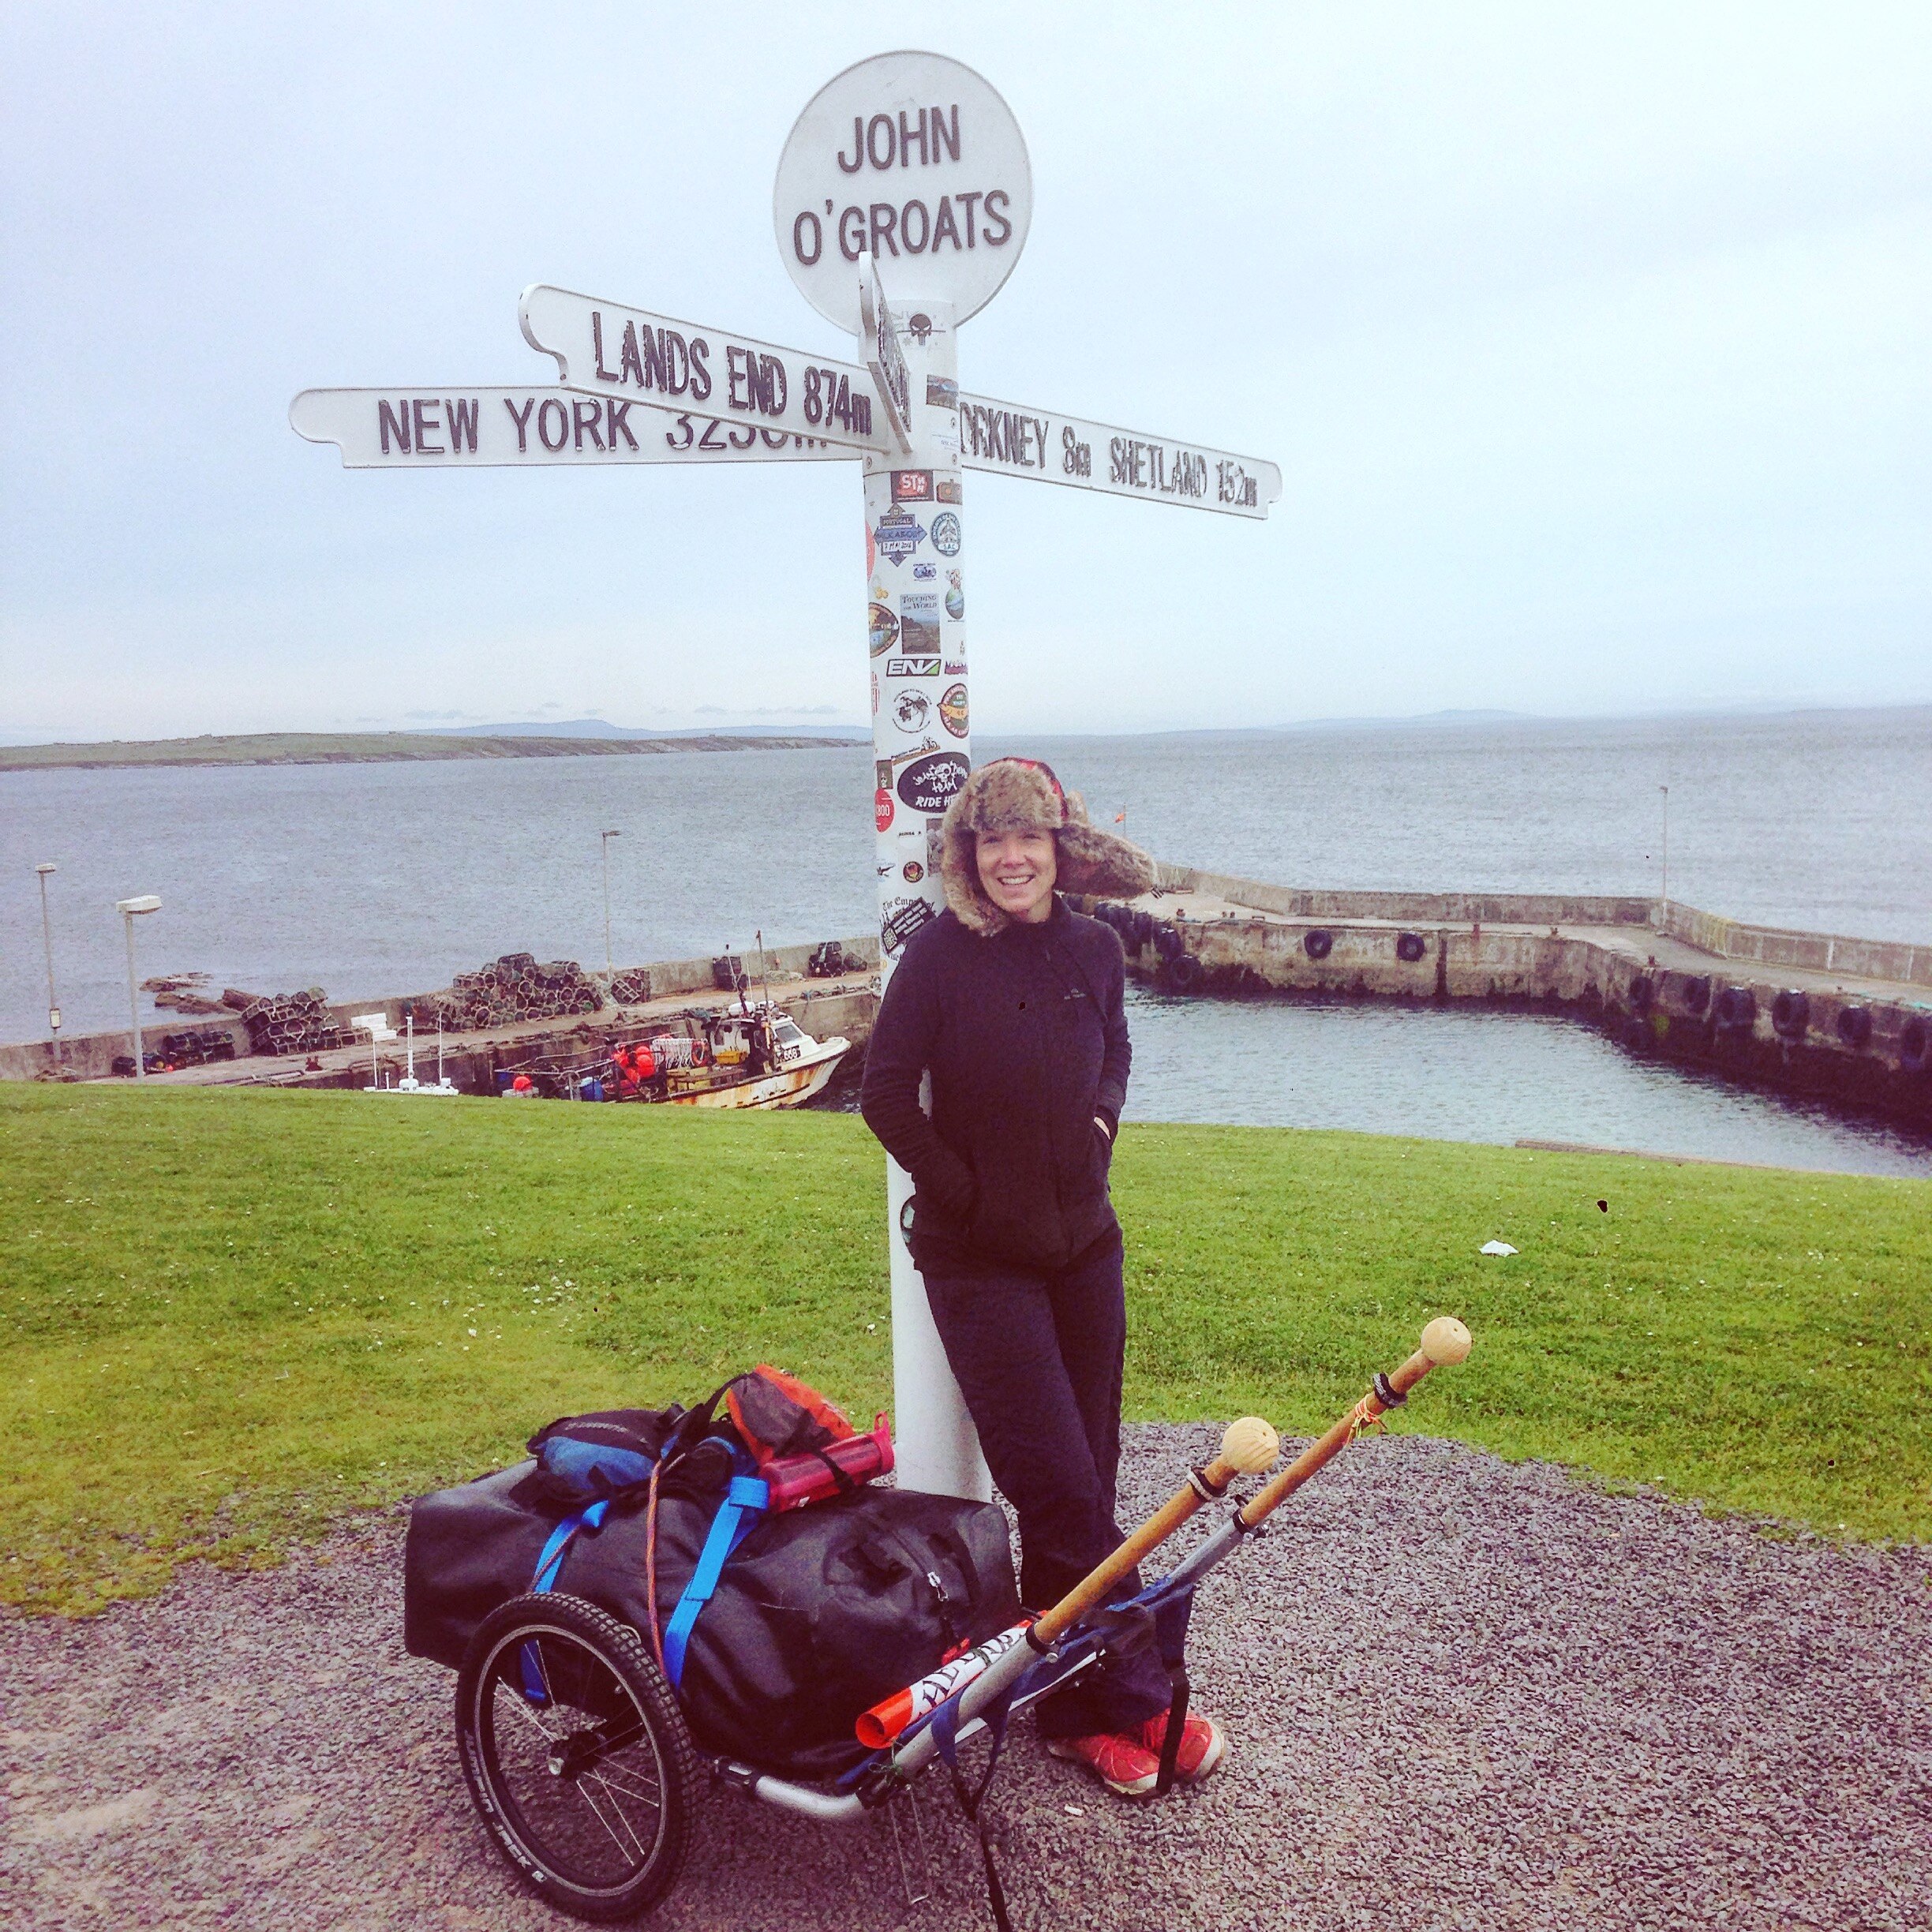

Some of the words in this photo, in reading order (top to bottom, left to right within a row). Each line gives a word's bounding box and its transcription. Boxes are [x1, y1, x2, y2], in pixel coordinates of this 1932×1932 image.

[837, 103, 961, 174] JOHN
[793, 189, 1013, 265] O'GROATS
[592, 310, 711, 400] LANDS
[728, 345, 788, 416] END
[803, 366, 873, 436] 874m
[376, 398, 478, 455] NEW
[504, 398, 639, 454] YORK
[960, 401, 1050, 470] ORKNEY
[1109, 436, 1208, 498] SHETLAND
[1216, 458, 1258, 508] 152m
[915, 796, 942, 807] RIDE
